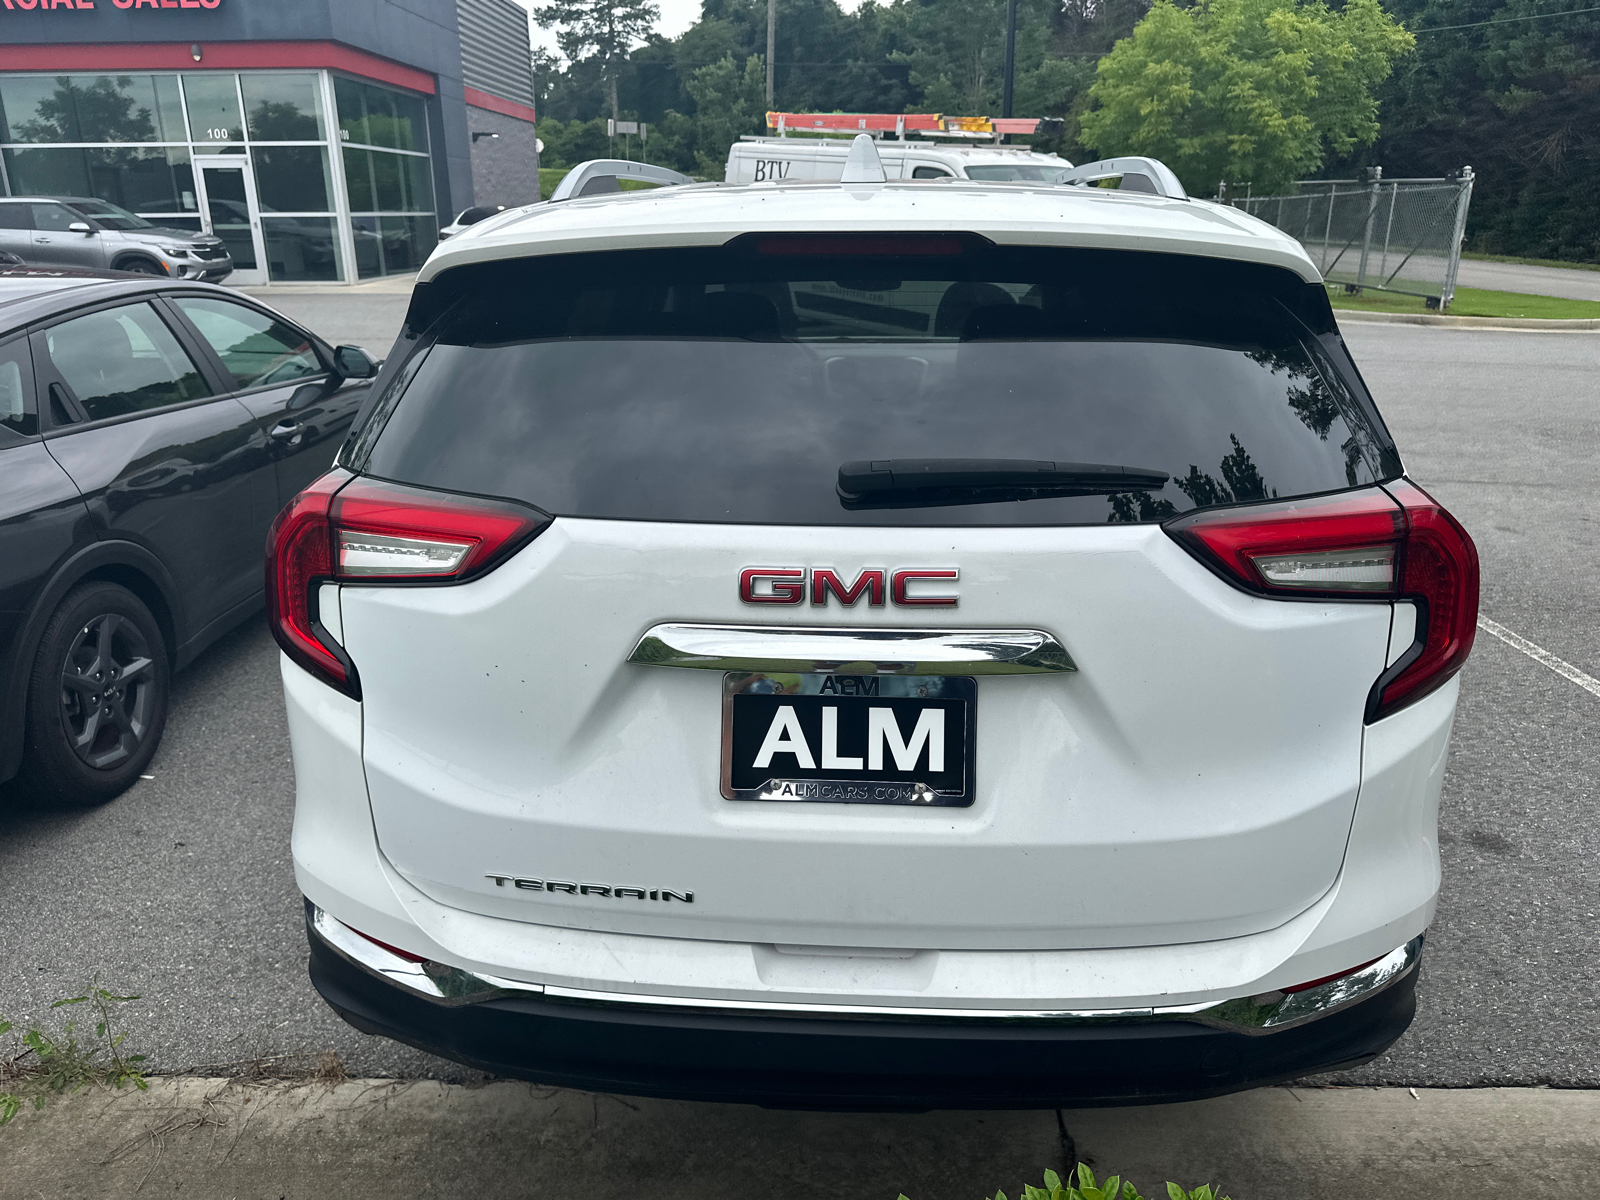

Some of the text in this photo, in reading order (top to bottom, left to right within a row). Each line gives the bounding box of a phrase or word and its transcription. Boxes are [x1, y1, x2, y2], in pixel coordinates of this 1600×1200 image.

[206, 128, 228, 139] 100
[754, 159, 791, 182] BTV
[739, 567, 960, 607] GMC
[819, 675, 880, 696] ALM
[752, 705, 944, 772] ALM
[781, 783, 914, 802] ALMCARS.COM
[484, 873, 694, 903] TERRAIN
